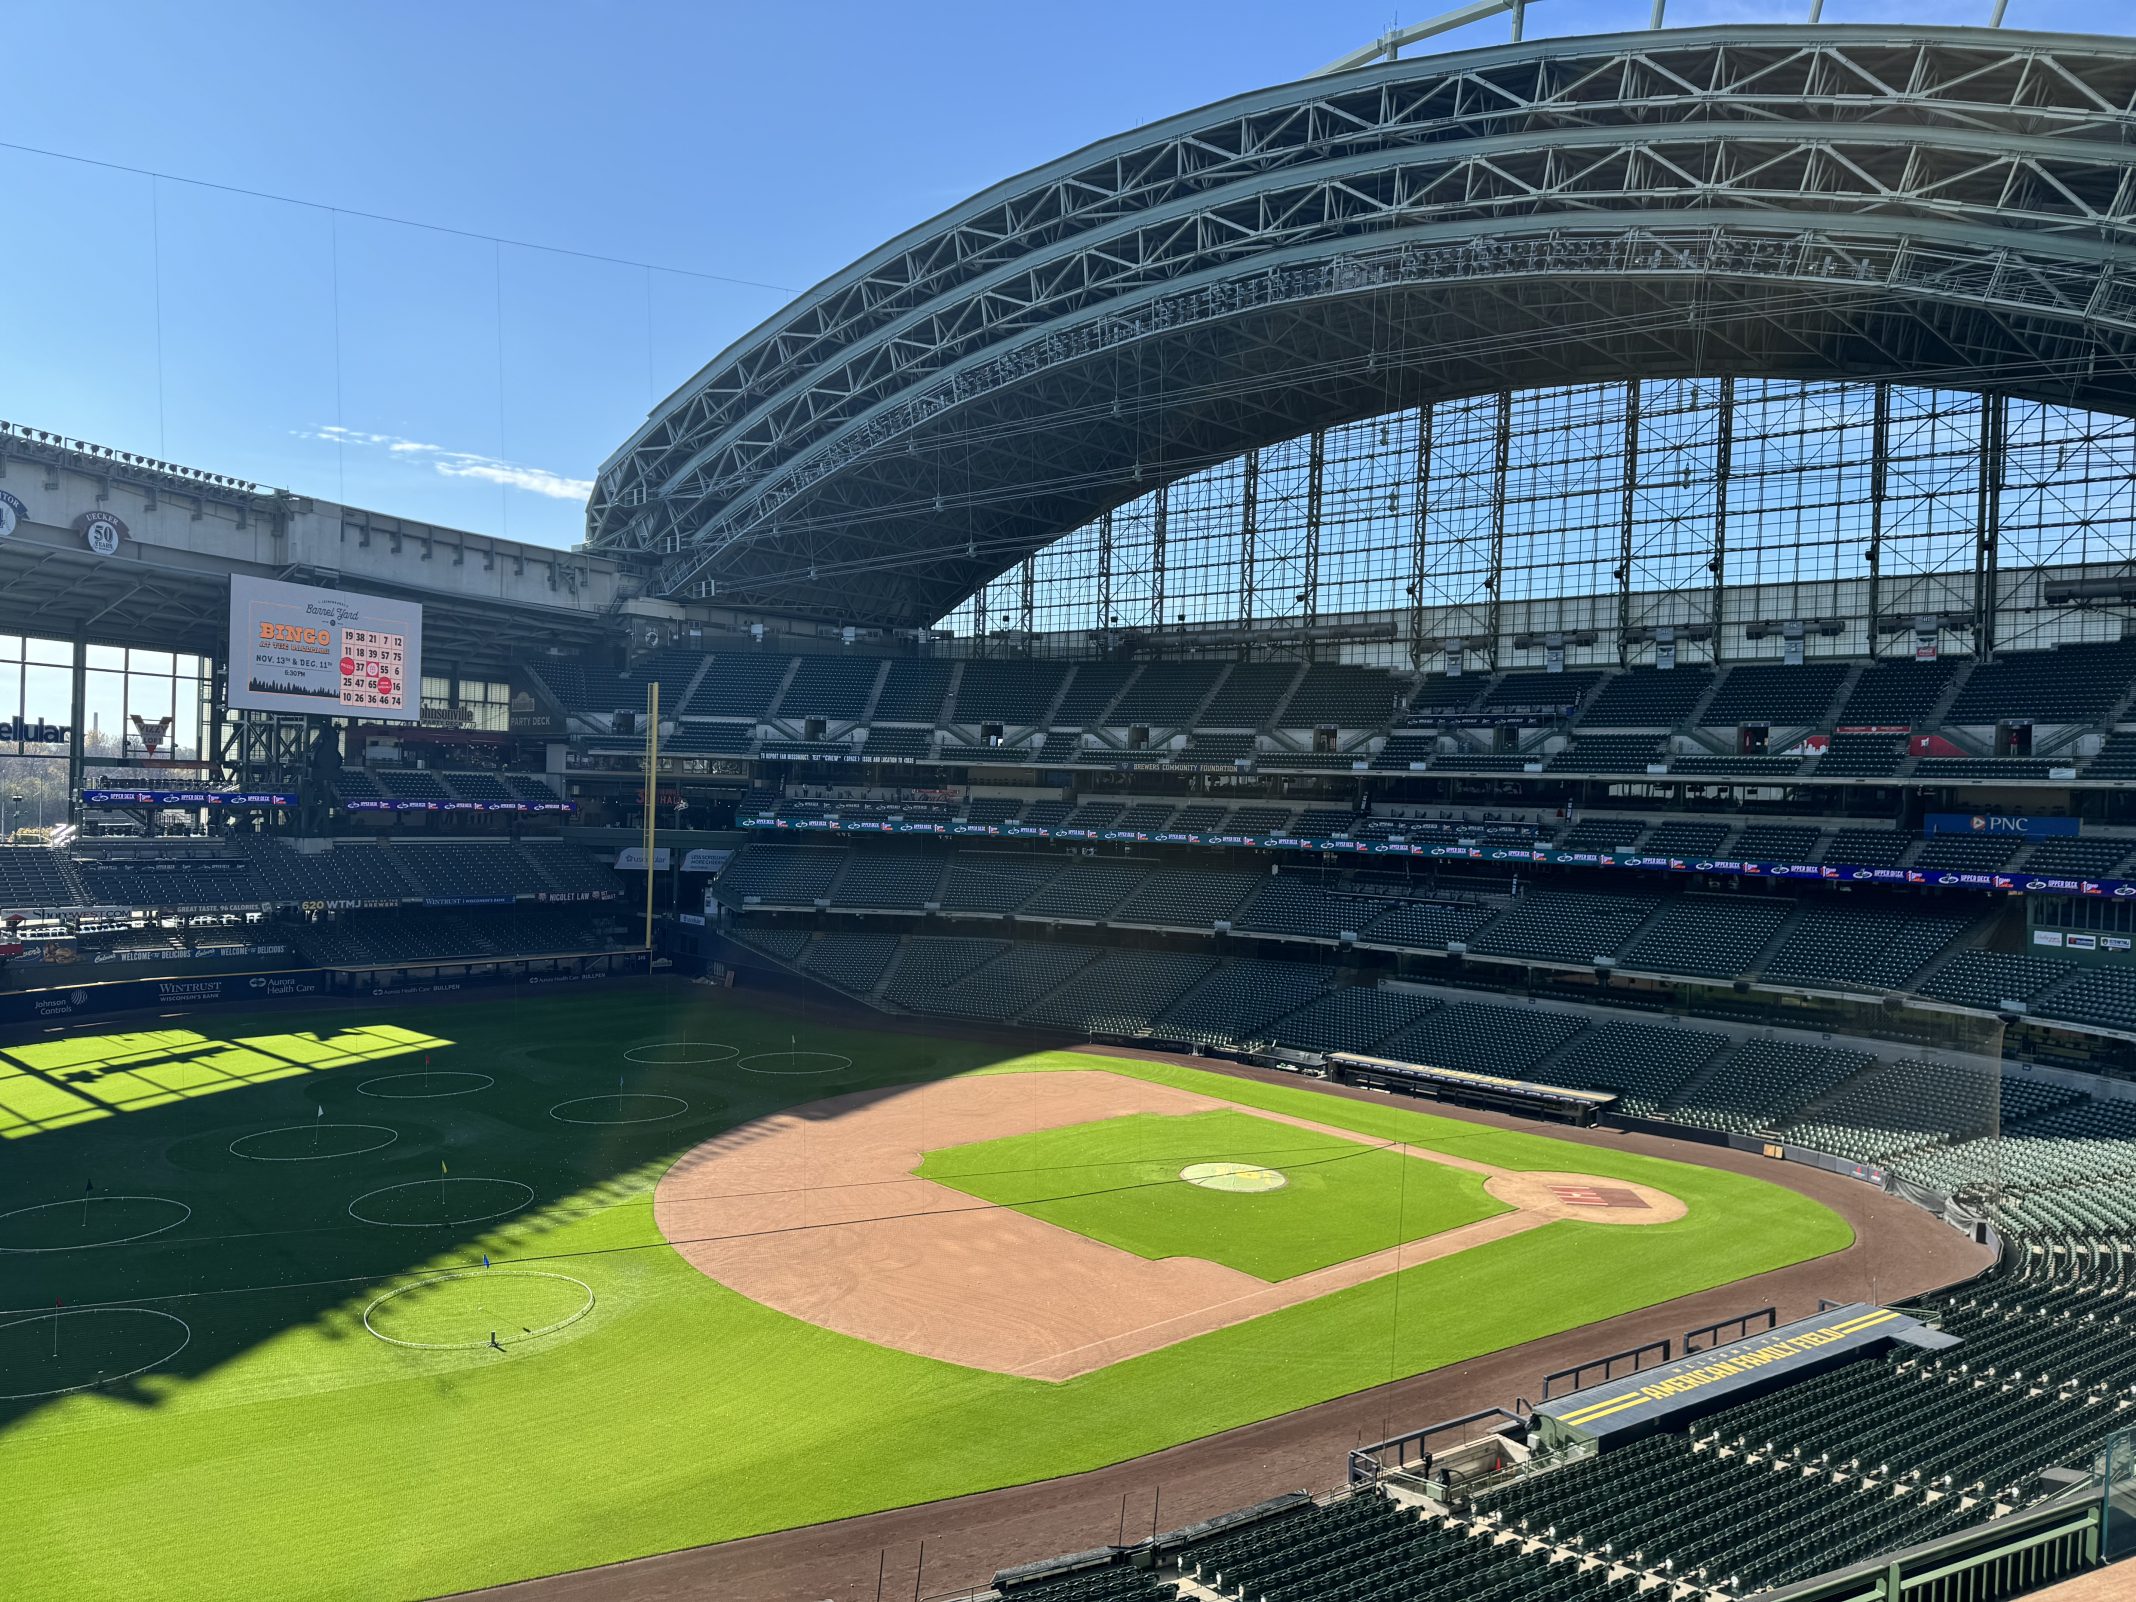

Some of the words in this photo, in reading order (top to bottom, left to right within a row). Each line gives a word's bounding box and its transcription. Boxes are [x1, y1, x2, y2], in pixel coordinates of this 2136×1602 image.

[86, 512, 118, 526] UECKER
[94, 525, 113, 543] 50
[95, 540, 113, 549] YEARS
[306, 604, 334, 616] Barrel
[337, 608, 359, 620] Yard
[259, 621, 330, 646] BINGO
[345, 631, 353, 640] 19
[356, 633, 365, 642] 38
[369, 635, 377, 643] 21
[394, 638, 402, 646] 12
[345, 647, 351, 655] 11
[356, 648, 364, 657] 18
[369, 649, 377, 658] 39
[381, 651, 389, 660] 57
[393, 653, 402, 661] 75
[256, 654, 274, 663] NOV.
[300, 659, 318, 668] DEC.
[356, 663, 364, 671] 37
[380, 666, 389, 674] 55
[344, 678, 352, 687] 25
[355, 679, 364, 688] 47
[368, 680, 377, 689] 65
[393, 682, 400, 691] 16
[343, 694, 351, 702] 10
[355, 694, 364, 703] 26
[368, 695, 377, 704] 36
[380, 696, 389, 705] 46
[392, 696, 401, 705] 74
[511, 717, 531, 726] PARTY
[532, 716, 550, 725] DECK
[140, 724, 168, 734] VIZZY
[1990, 817, 2029, 832] PNC
[1714, 861, 1728, 869] UPPER
[1728, 861, 1740, 869] DECK
[1790, 865, 1804, 873] UPPER
[1805, 865, 1818, 873] DECK
[1874, 870, 1888, 878] UPPER
[1889, 870, 1904, 878] DECK
[1960, 875, 1976, 884] UPPER
[1977, 875, 1990, 884] DECK
[2048, 880, 2063, 889] UPPER
[2064, 880, 2078, 889] DECK
[549, 893, 575, 901] NICOLET
[577, 892, 589, 901] LAW
[302, 901, 324, 910] 620
[326, 900, 362, 909] WTMJ
[121, 951, 151, 961] WELCOME
[162, 950, 191, 959] DELICIOUS
[220, 948, 248, 956] WELCOME
[258, 946, 285, 954] DELICIOUS
[95, 953, 116, 964] Culver's
[159, 982, 221, 994] WINTRUST
[267, 985, 293, 994] Health
[160, 993, 201, 1002] WISCONSIN'S
[35, 999, 66, 1009] Johnson
[40, 1005, 72, 1015] Controls
[1640, 1361, 1744, 1400] AMERICAN
[1728, 1342, 1802, 1369] FAMILY
[1786, 1328, 1846, 1349] FIELD
